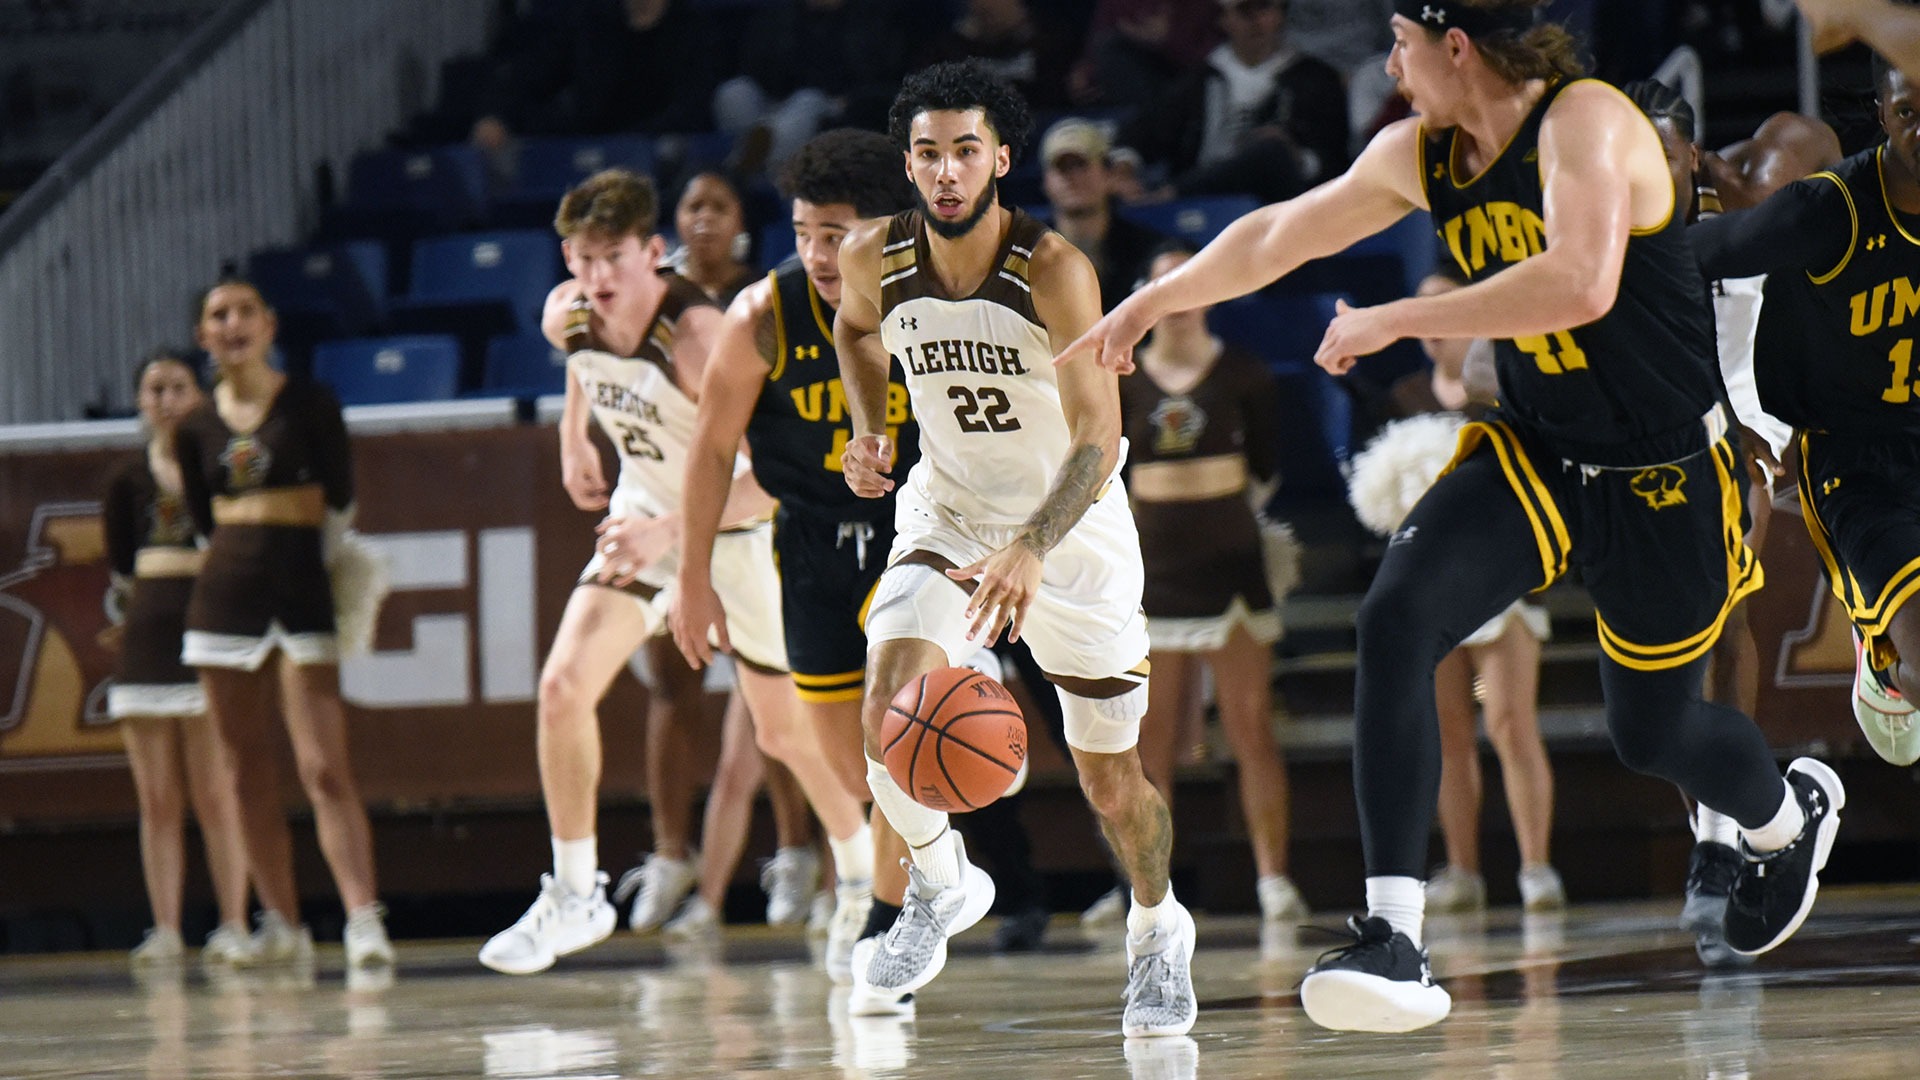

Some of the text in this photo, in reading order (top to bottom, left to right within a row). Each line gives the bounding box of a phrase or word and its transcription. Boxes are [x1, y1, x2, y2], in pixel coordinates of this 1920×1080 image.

[905, 340, 1027, 376] LEHIGH
[1881, 338, 1920, 404] 1
[790, 378, 917, 424] UB
[947, 385, 1022, 433] 22
[614, 420, 665, 462] 25
